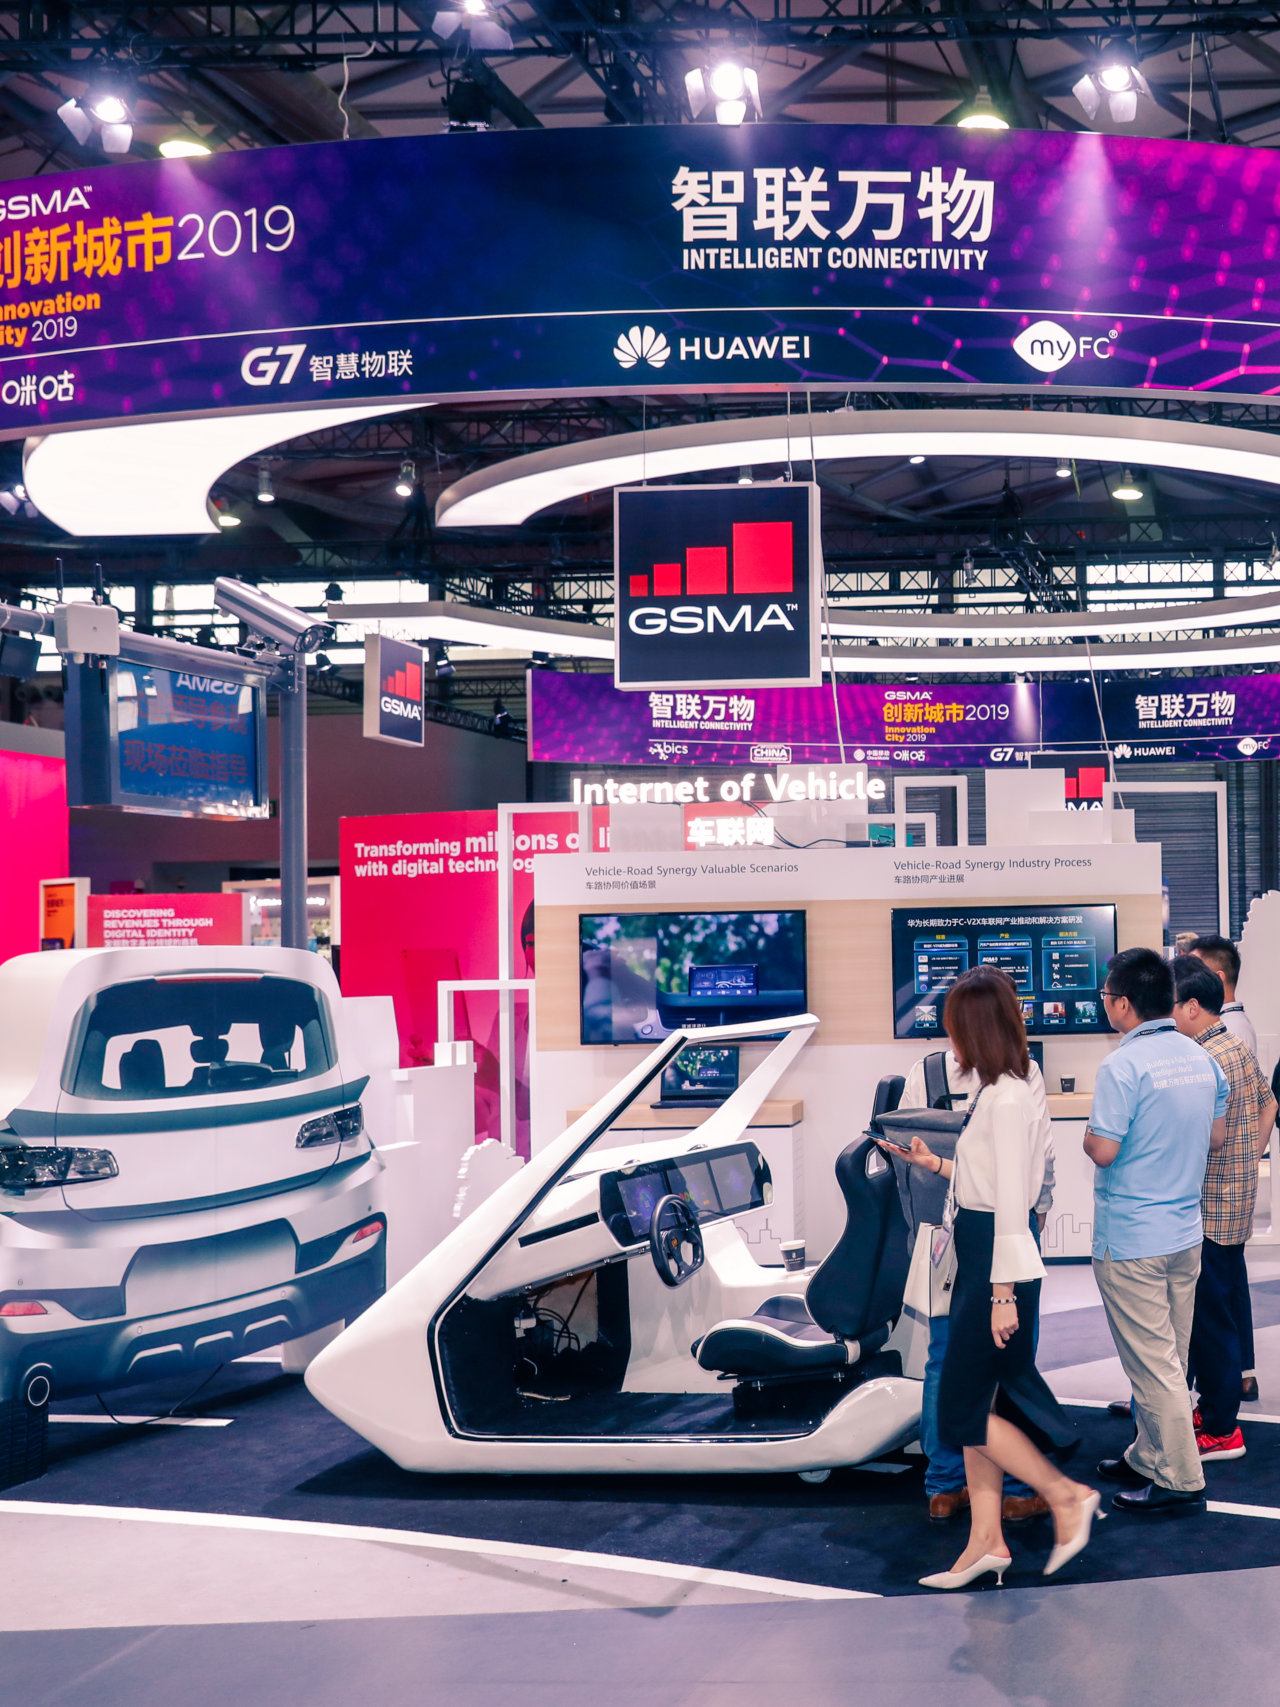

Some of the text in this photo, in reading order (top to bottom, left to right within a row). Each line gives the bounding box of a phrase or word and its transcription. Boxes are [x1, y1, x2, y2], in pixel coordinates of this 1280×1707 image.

[671, 165, 995, 242] 智联万物
[683, 247, 989, 271] INTELLIGENT CONNECTIVITY
[0, 291, 101, 322] novation
[31, 315, 78, 342] 2019
[679, 336, 811, 361] HUAWEI
[240, 343, 307, 387] G7
[309, 349, 413, 382] 智慧物联
[2, 370, 75, 406] 咪咕
[648, 691, 755, 721] 智联万物
[1135, 690, 1236, 720] 智联万物
[652, 719, 753, 731] INTELLIGENT CONNECTIVITY
[884, 726, 936, 734] Innovation
[1138, 717, 1234, 729] INTELLIGENT CONNECTIVITY
[884, 733, 927, 743] City 2019
[663, 742, 689, 754] bics
[753, 748, 788, 758] CHINA
[990, 748, 1014, 761] G7
[1133, 746, 1176, 757] HUAWEI
[893, 750, 926, 762] 咪咕
[573, 769, 887, 805] Internet of Vehicle
[687, 817, 775, 847] 车联网
[354, 838, 461, 859] Transforming
[465, 830, 559, 853] milons
[354, 860, 388, 877] with
[391, 858, 444, 878] digital
[585, 862, 799, 877] Vehicle-Road Synergy Valuable Scenarios
[893, 857, 1092, 872] Vehicle-Road Synergy Industry Process
[585, 880, 657, 890] 车路协同价值场景
[894, 874, 965, 884] 车路协同产业进展
[103, 908, 176, 918] DISCOVERING
[103, 918, 214, 928] REVENUES THROUGH
[103, 928, 195, 938] DIGITAL IDENTITY
